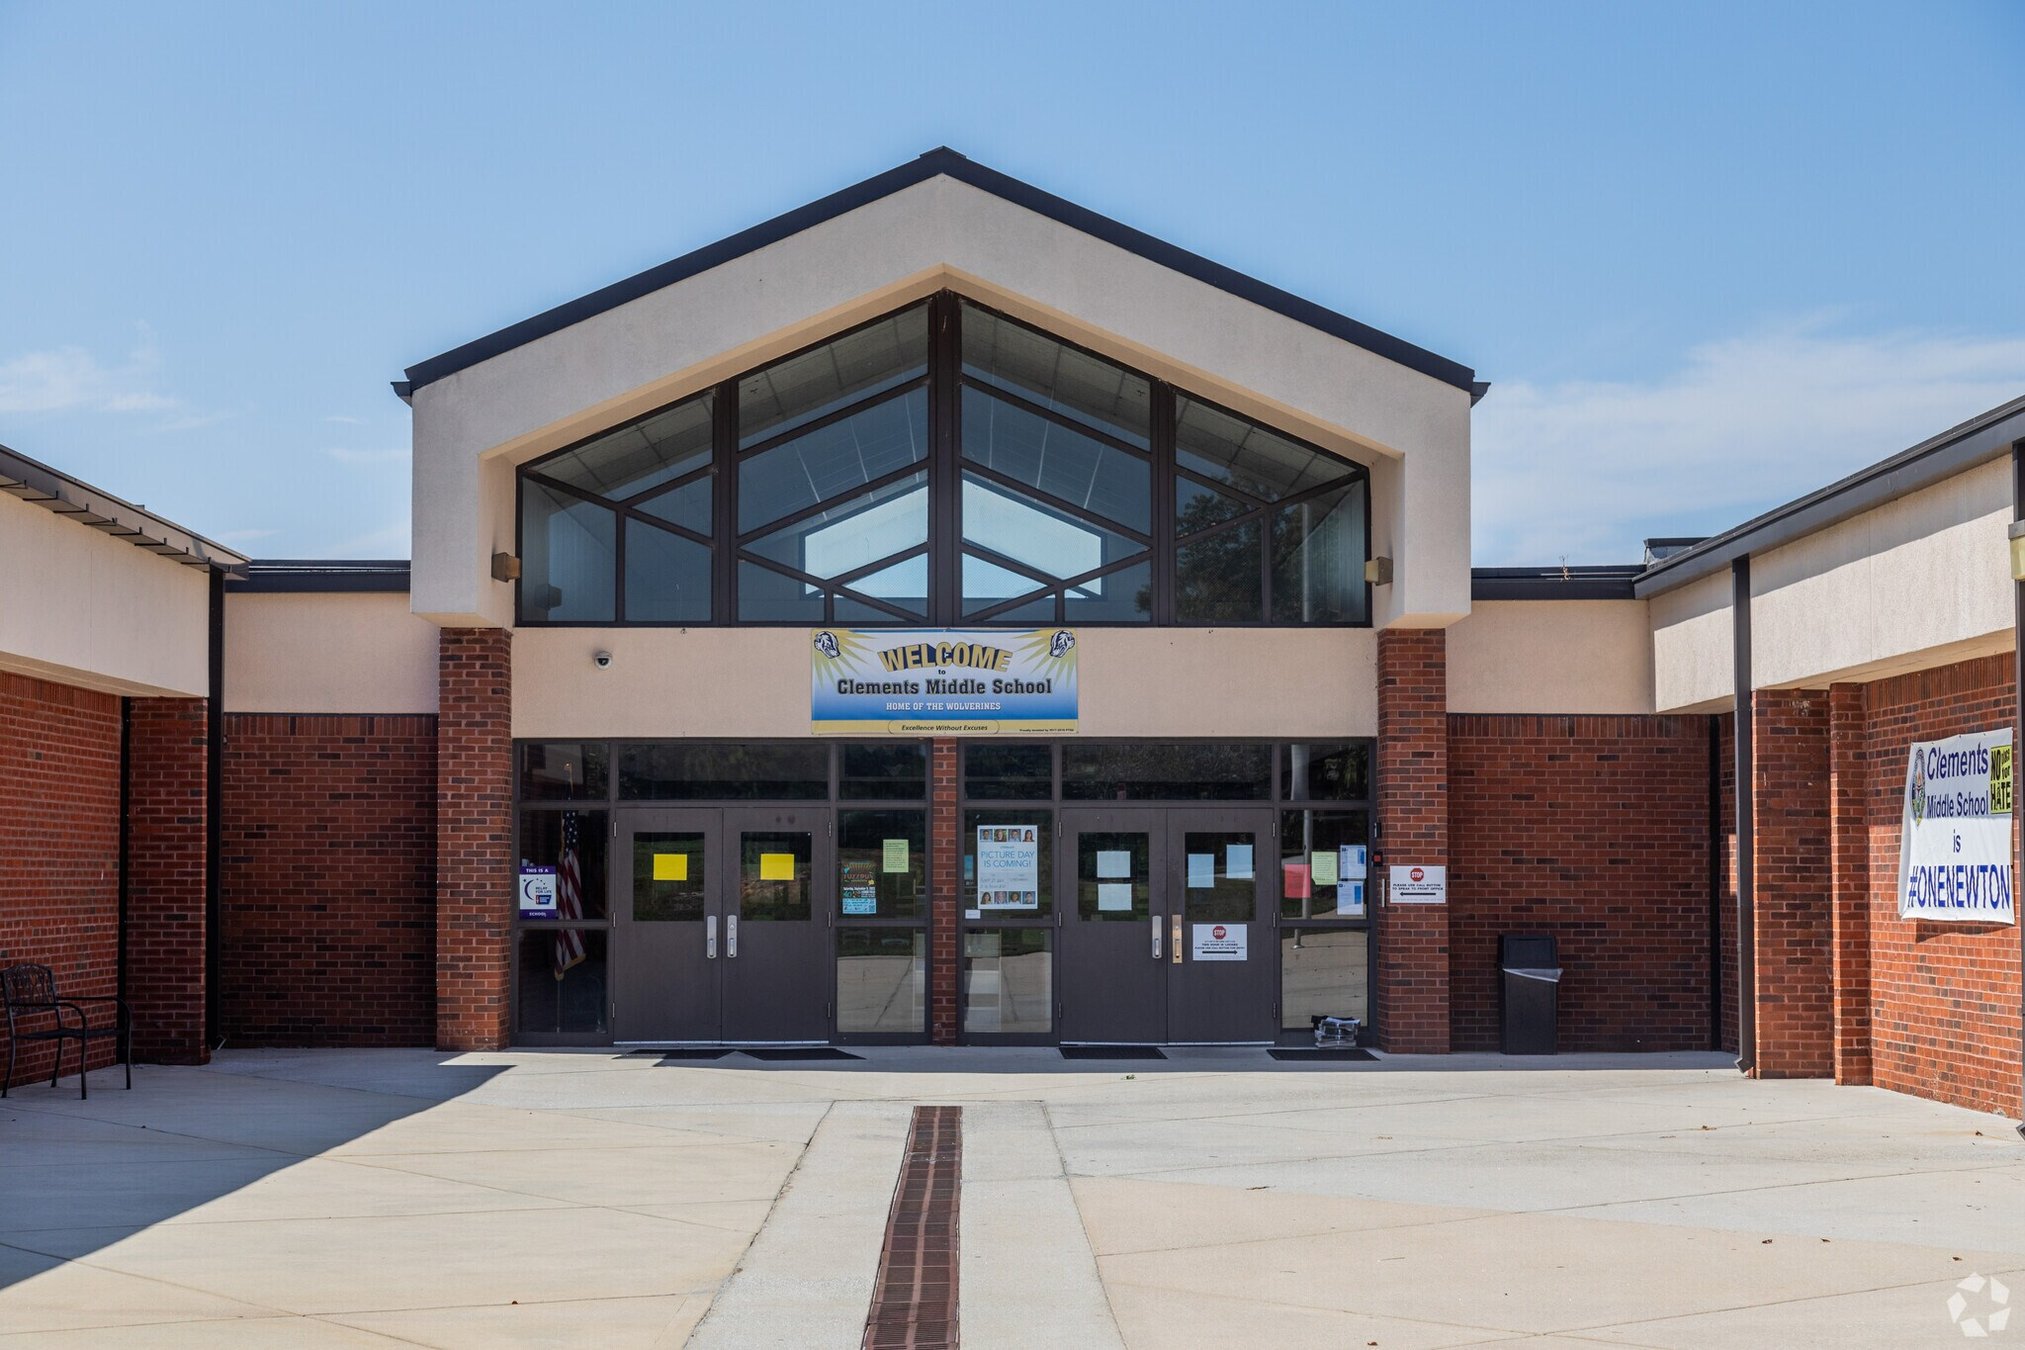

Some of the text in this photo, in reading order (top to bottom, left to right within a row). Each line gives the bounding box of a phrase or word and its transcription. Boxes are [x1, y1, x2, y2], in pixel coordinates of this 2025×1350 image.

[877, 642, 1013, 672] WELCOME
[837, 678, 1052, 695] Clements Middle School
[886, 702, 1001, 710] HOME OF THE WOLVERINES
[1927, 742, 1988, 781] Clements
[1990, 749, 2001, 781] NO
[1926, 790, 1989, 819] Middle School
[1990, 781, 2011, 811] HATE
[981, 851, 1034, 859] PICTURE DAY
[1953, 829, 1961, 853] is
[984, 860, 1031, 868] IS COMING!
[1907, 864, 2010, 910] #ONENEWTON
